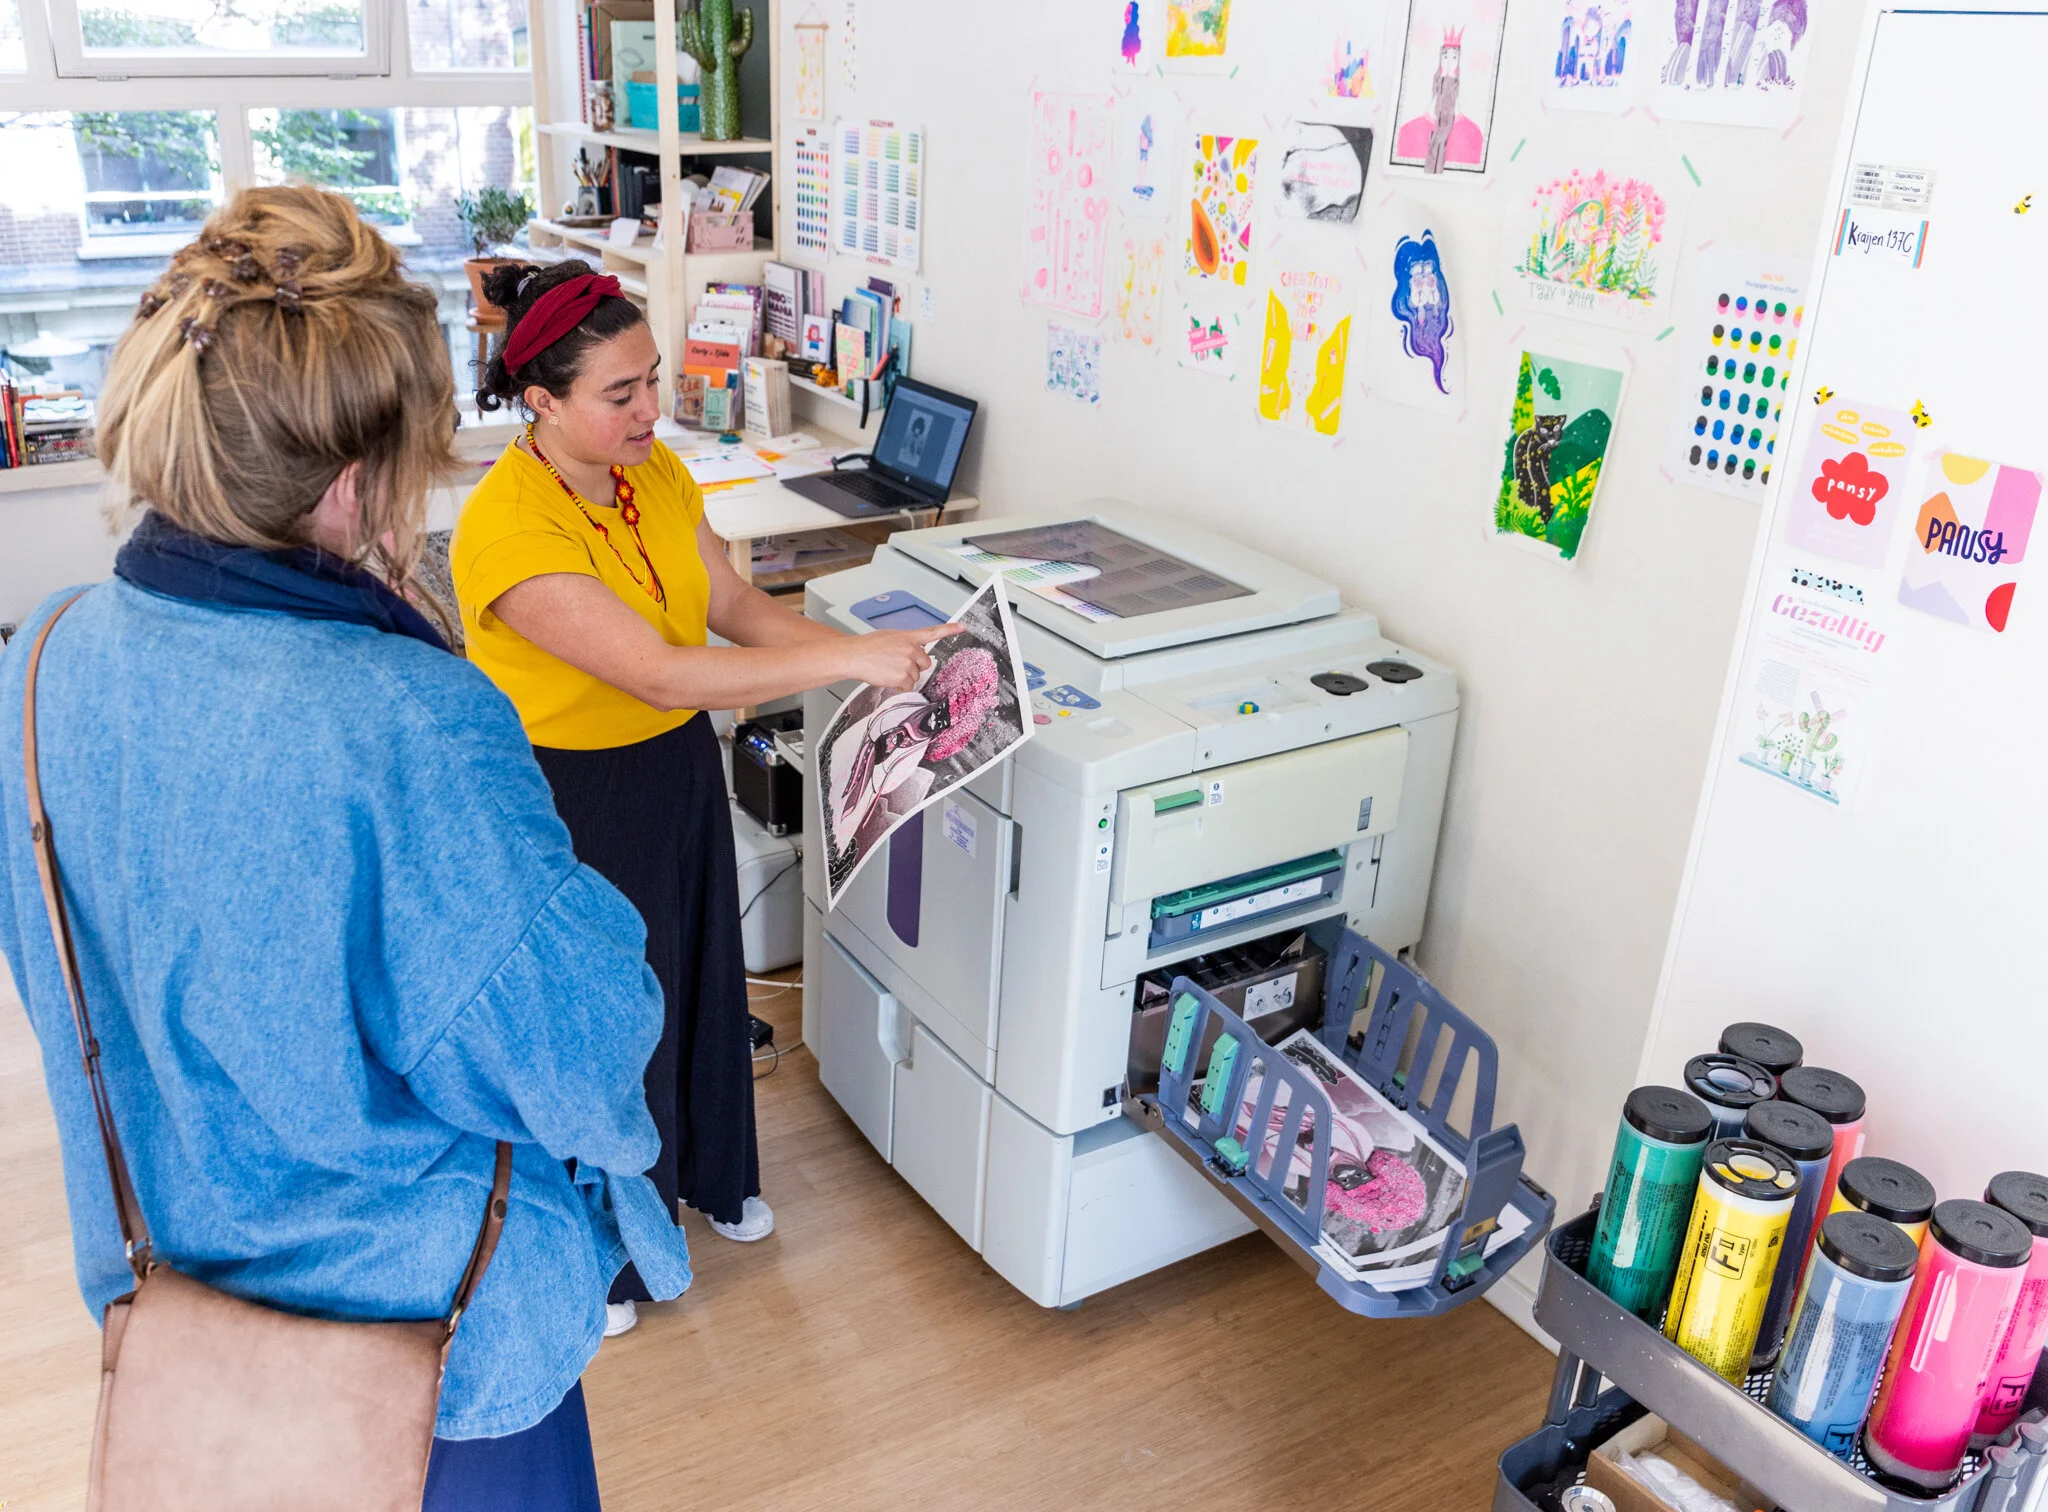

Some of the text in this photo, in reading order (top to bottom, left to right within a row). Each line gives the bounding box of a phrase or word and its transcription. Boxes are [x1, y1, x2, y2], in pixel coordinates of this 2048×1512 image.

[1848, 221, 1914, 254] Kraijen 137C
[768, 301, 793, 317] MANIA
[1827, 478, 1877, 501] pansy
[1925, 517, 2008, 565] PANSY
[1771, 593, 1886, 653] Gezellig
[1711, 1246, 1739, 1272] F
[1738, 1243, 1746, 1256] type
[2002, 1383, 2026, 1397] F
[1830, 1431, 1855, 1445] F
